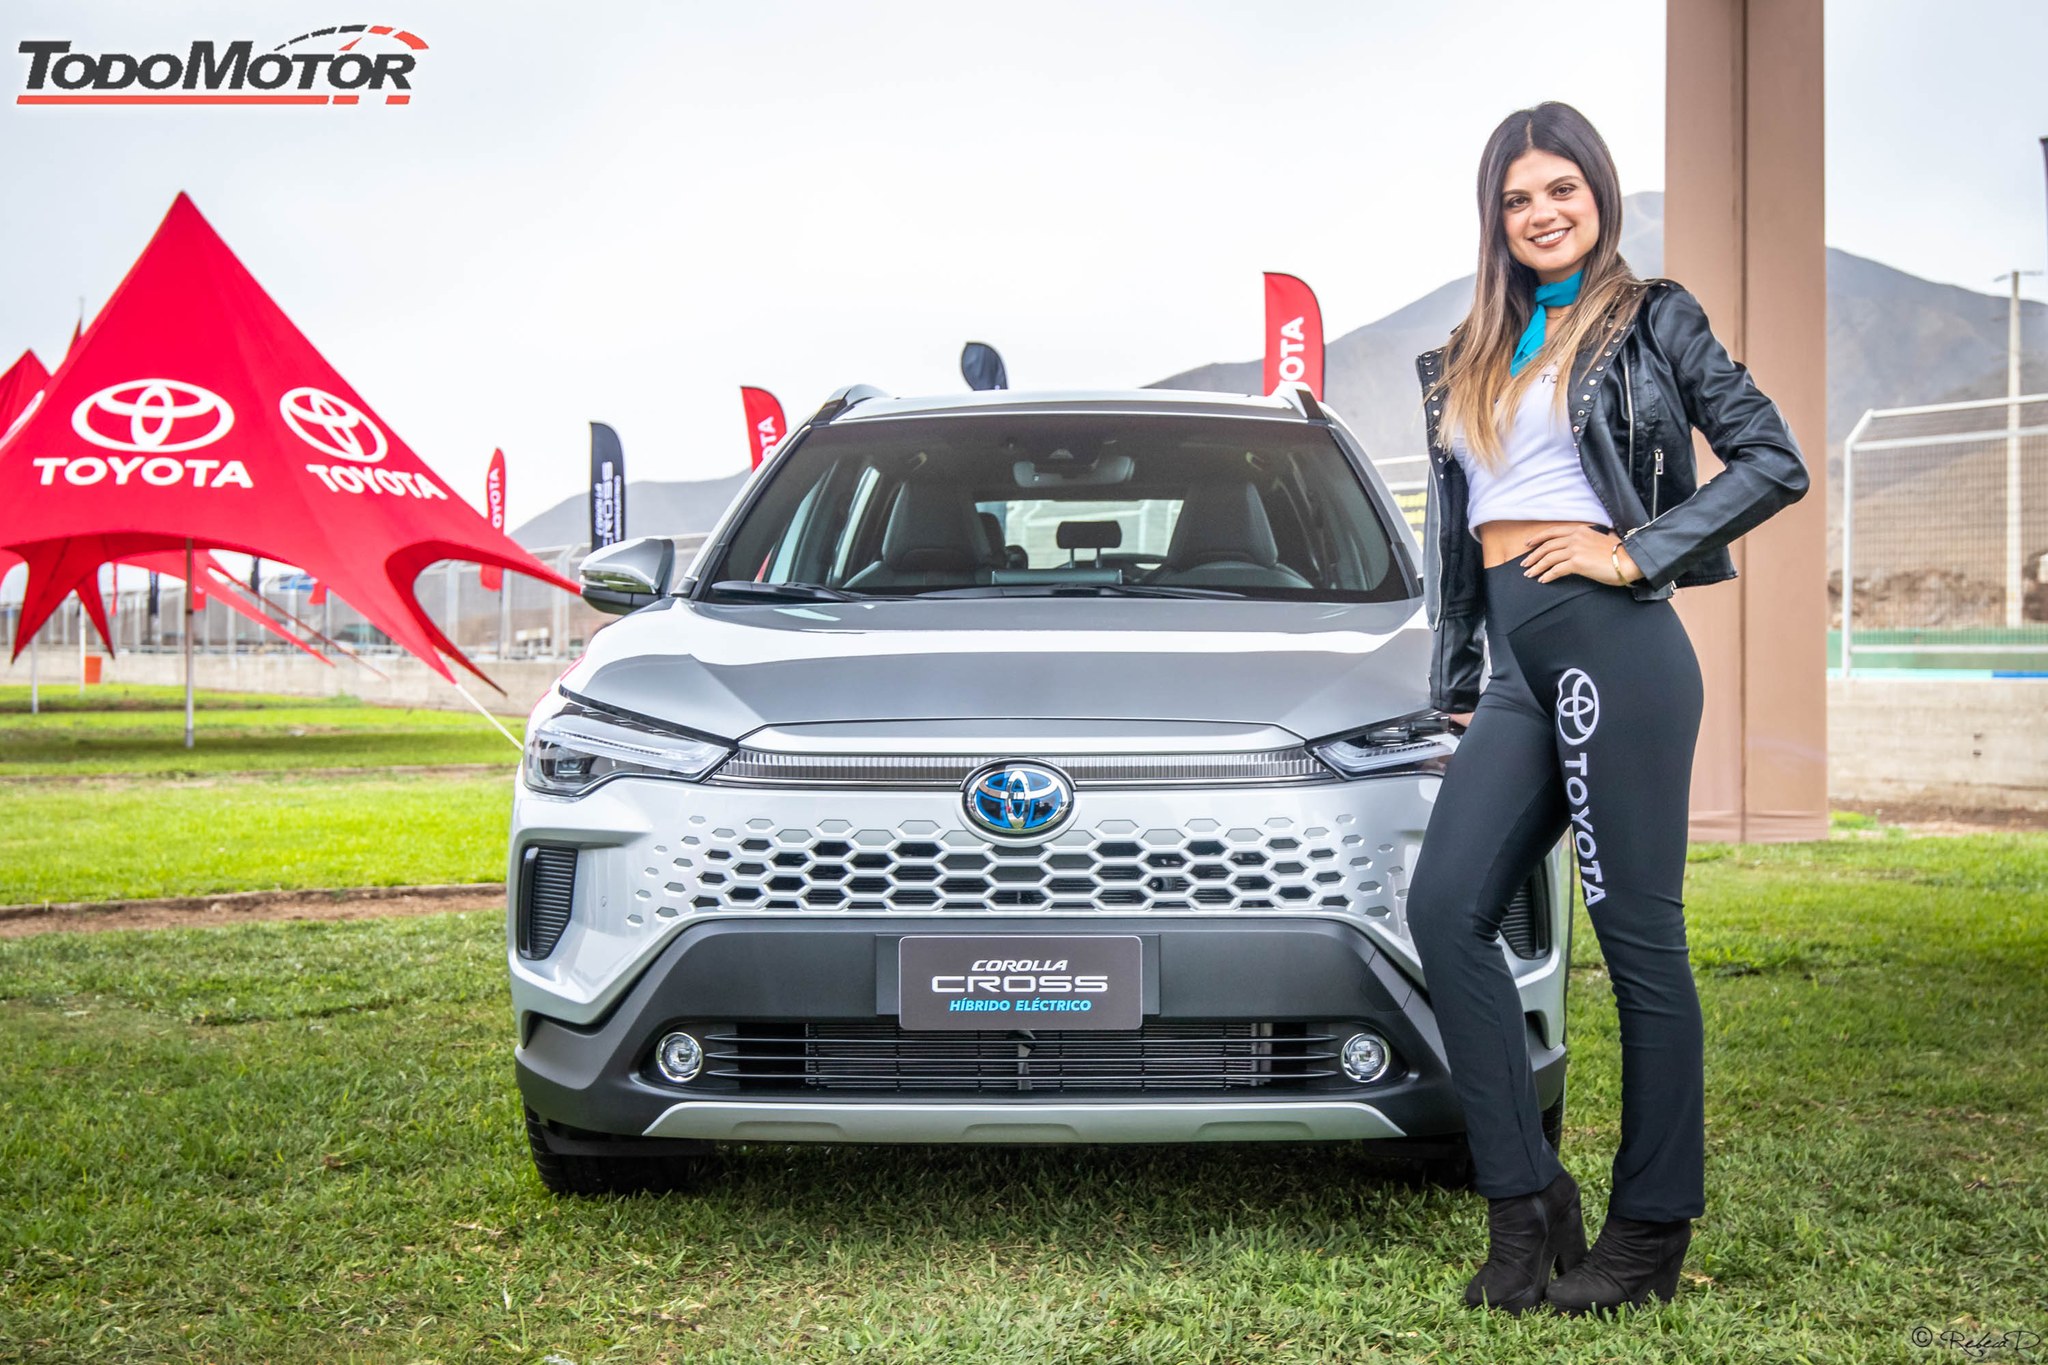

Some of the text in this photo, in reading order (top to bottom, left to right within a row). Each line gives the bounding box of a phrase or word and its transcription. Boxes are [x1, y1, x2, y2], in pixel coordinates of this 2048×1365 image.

[33, 456, 253, 488] TOYOTA
[306, 464, 448, 500] TOYOTA
[1565, 752, 1606, 906] TOYOTA
[971, 959, 1068, 972] COROLLA
[932, 975, 1108, 993] CROSS
[950, 997, 1092, 1012] HÍBRIDO ELÉCTRICO
